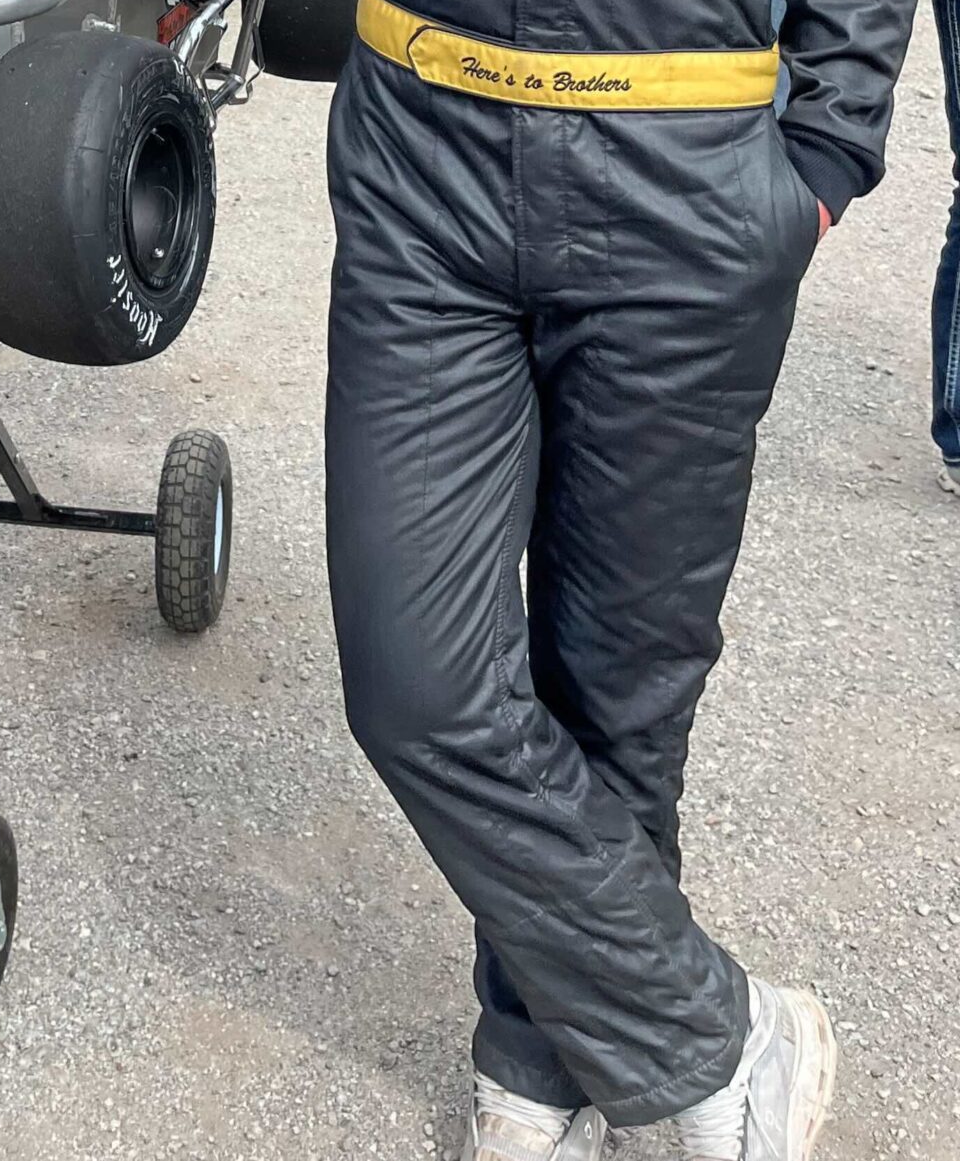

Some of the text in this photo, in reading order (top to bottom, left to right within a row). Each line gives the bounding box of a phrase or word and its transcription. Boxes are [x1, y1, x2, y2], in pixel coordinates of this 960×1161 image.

[461, 56, 632, 92] Here's to Brothers
